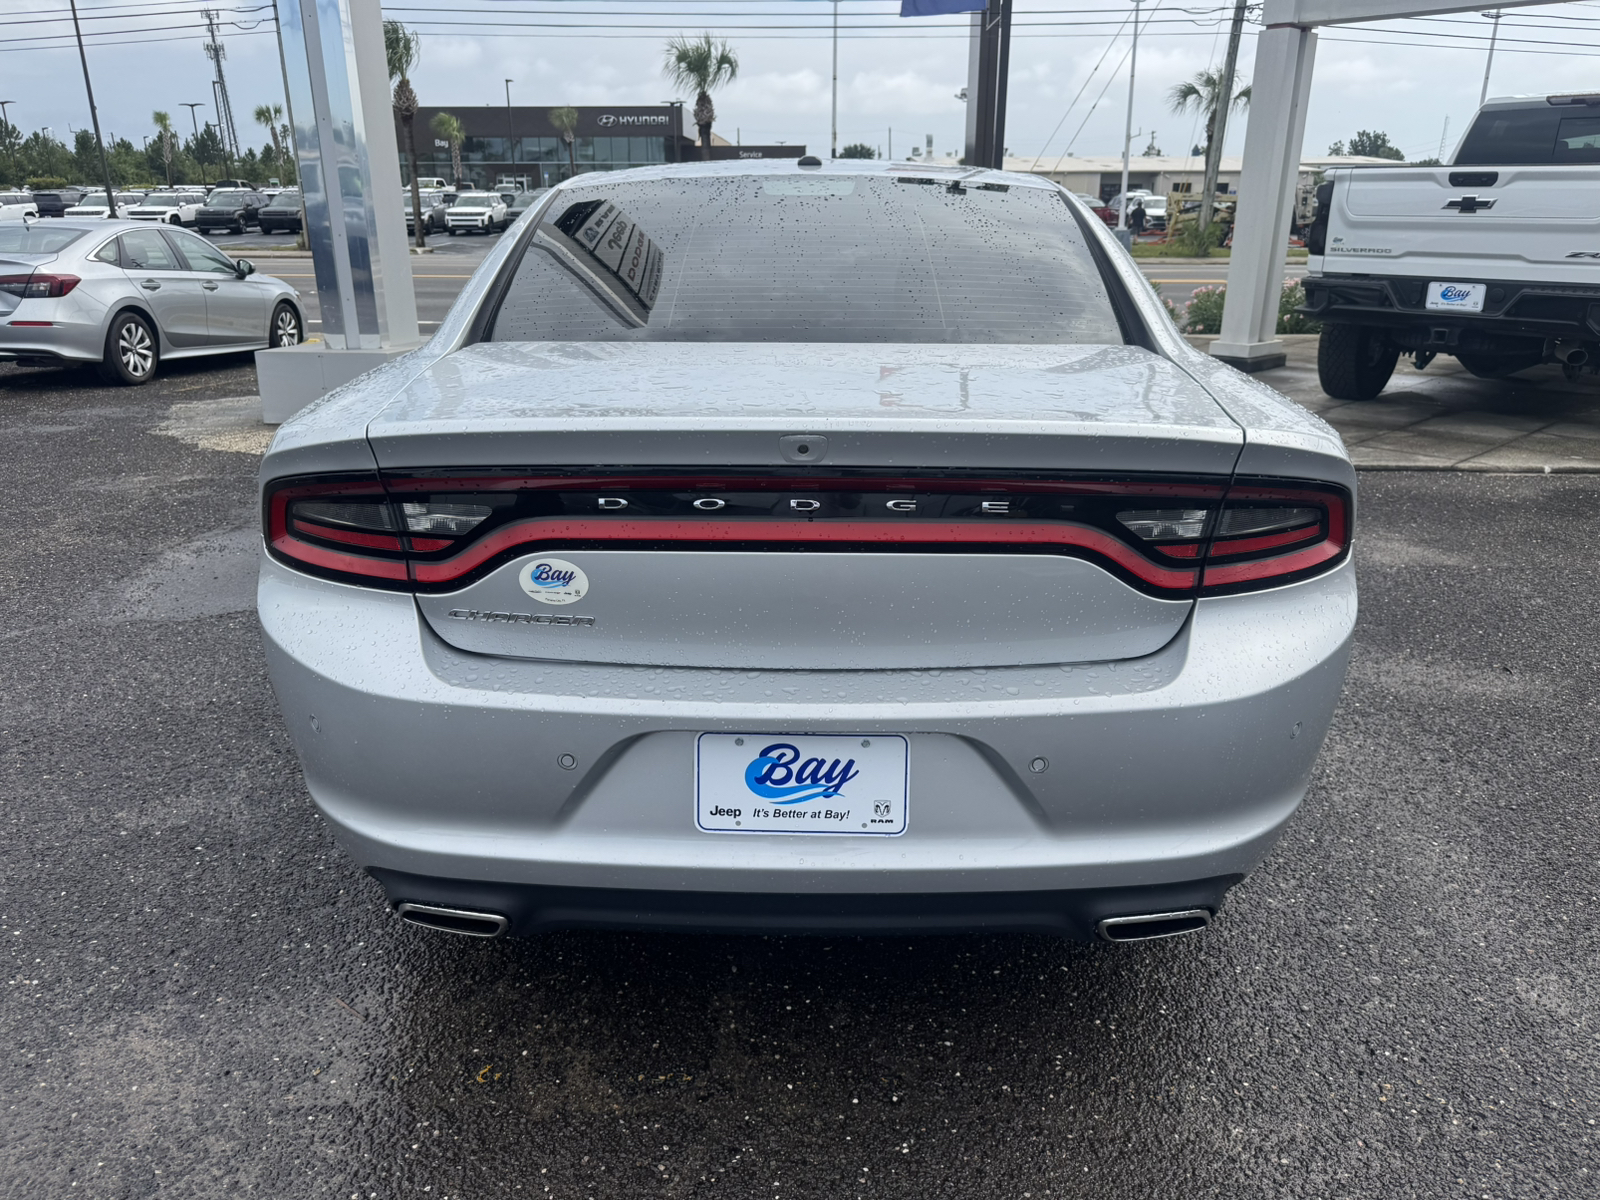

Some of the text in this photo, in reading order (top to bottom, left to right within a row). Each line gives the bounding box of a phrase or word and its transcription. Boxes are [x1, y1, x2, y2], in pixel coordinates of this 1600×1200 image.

[619, 115, 669, 126] HYUNDAI
[434, 138, 449, 149] Bay
[739, 150, 763, 159] Service
[1443, 285, 1472, 301] Bay
[598, 497, 1010, 513] DODGE
[534, 563, 577, 587] Bay
[447, 608, 596, 628] CHARGER
[753, 742, 860, 799] Bay
[709, 805, 742, 819] Jeep
[752, 807, 851, 822] It's Better at Bay!
